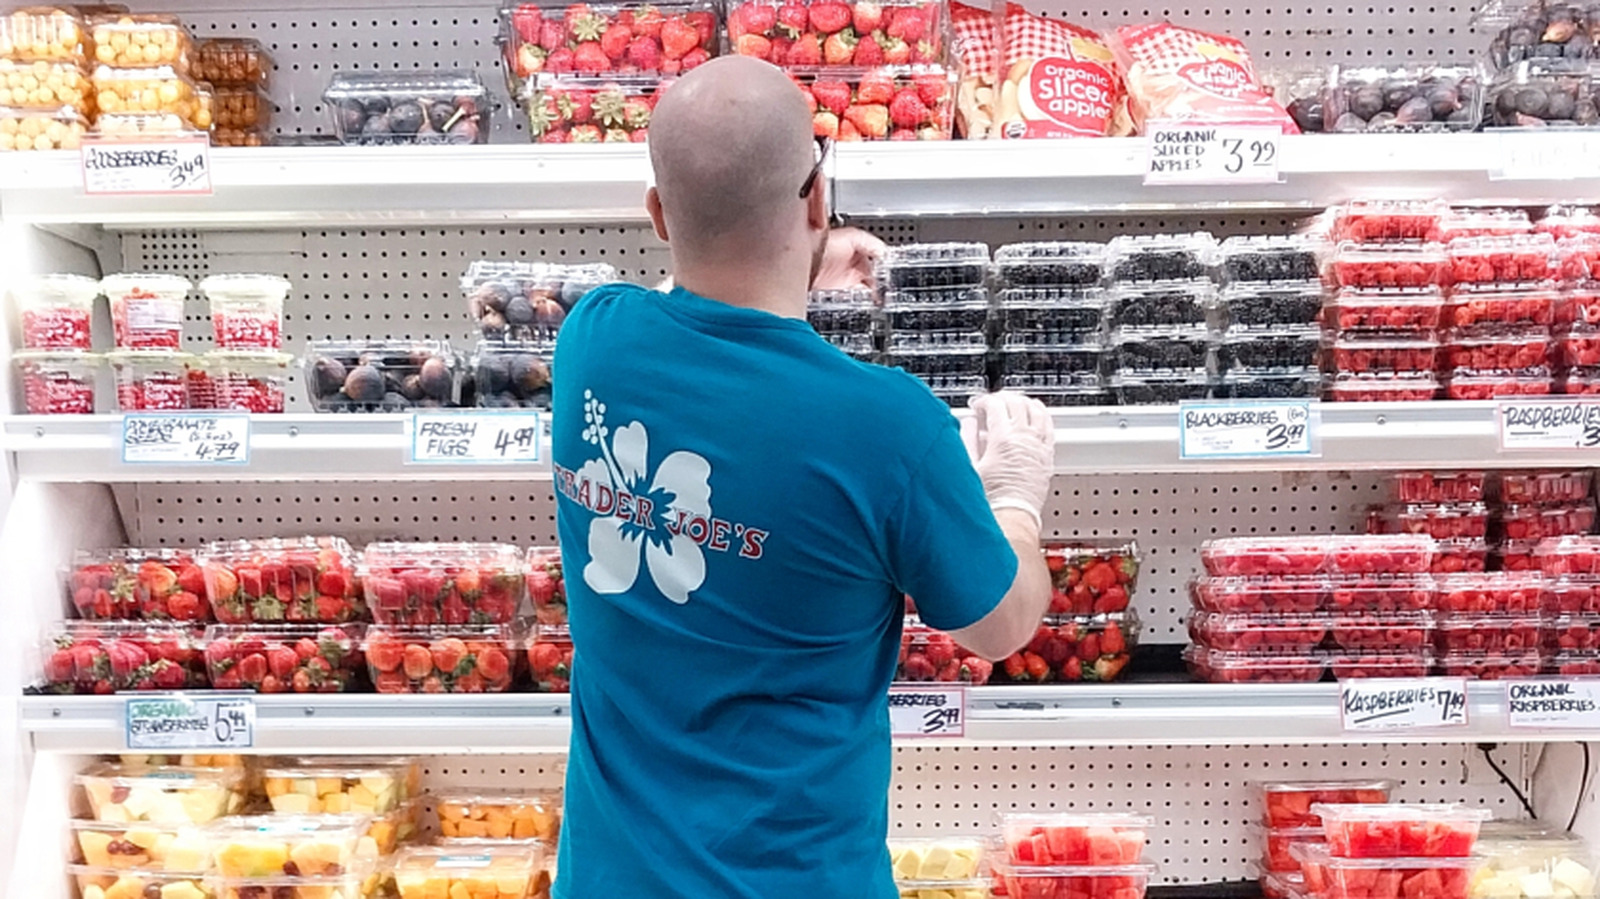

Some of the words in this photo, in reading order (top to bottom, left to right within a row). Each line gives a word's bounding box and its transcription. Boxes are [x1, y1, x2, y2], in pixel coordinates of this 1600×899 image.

[1044, 64, 1109, 87] organic
[1154, 129, 1217, 143] ORGANIC
[1153, 144, 1205, 157] SLICED
[1150, 158, 1202, 172] APPLES
[1502, 403, 1600, 429] RASPBERRIE
[420, 421, 478, 437] FRESH
[426, 439, 471, 456] FIGS
[553, 462, 655, 530] TRADER
[664, 506, 769, 559] JOE'S
[1509, 683, 1576, 700] ORGANIC
[1341, 686, 1435, 715] RASPBERRIES
